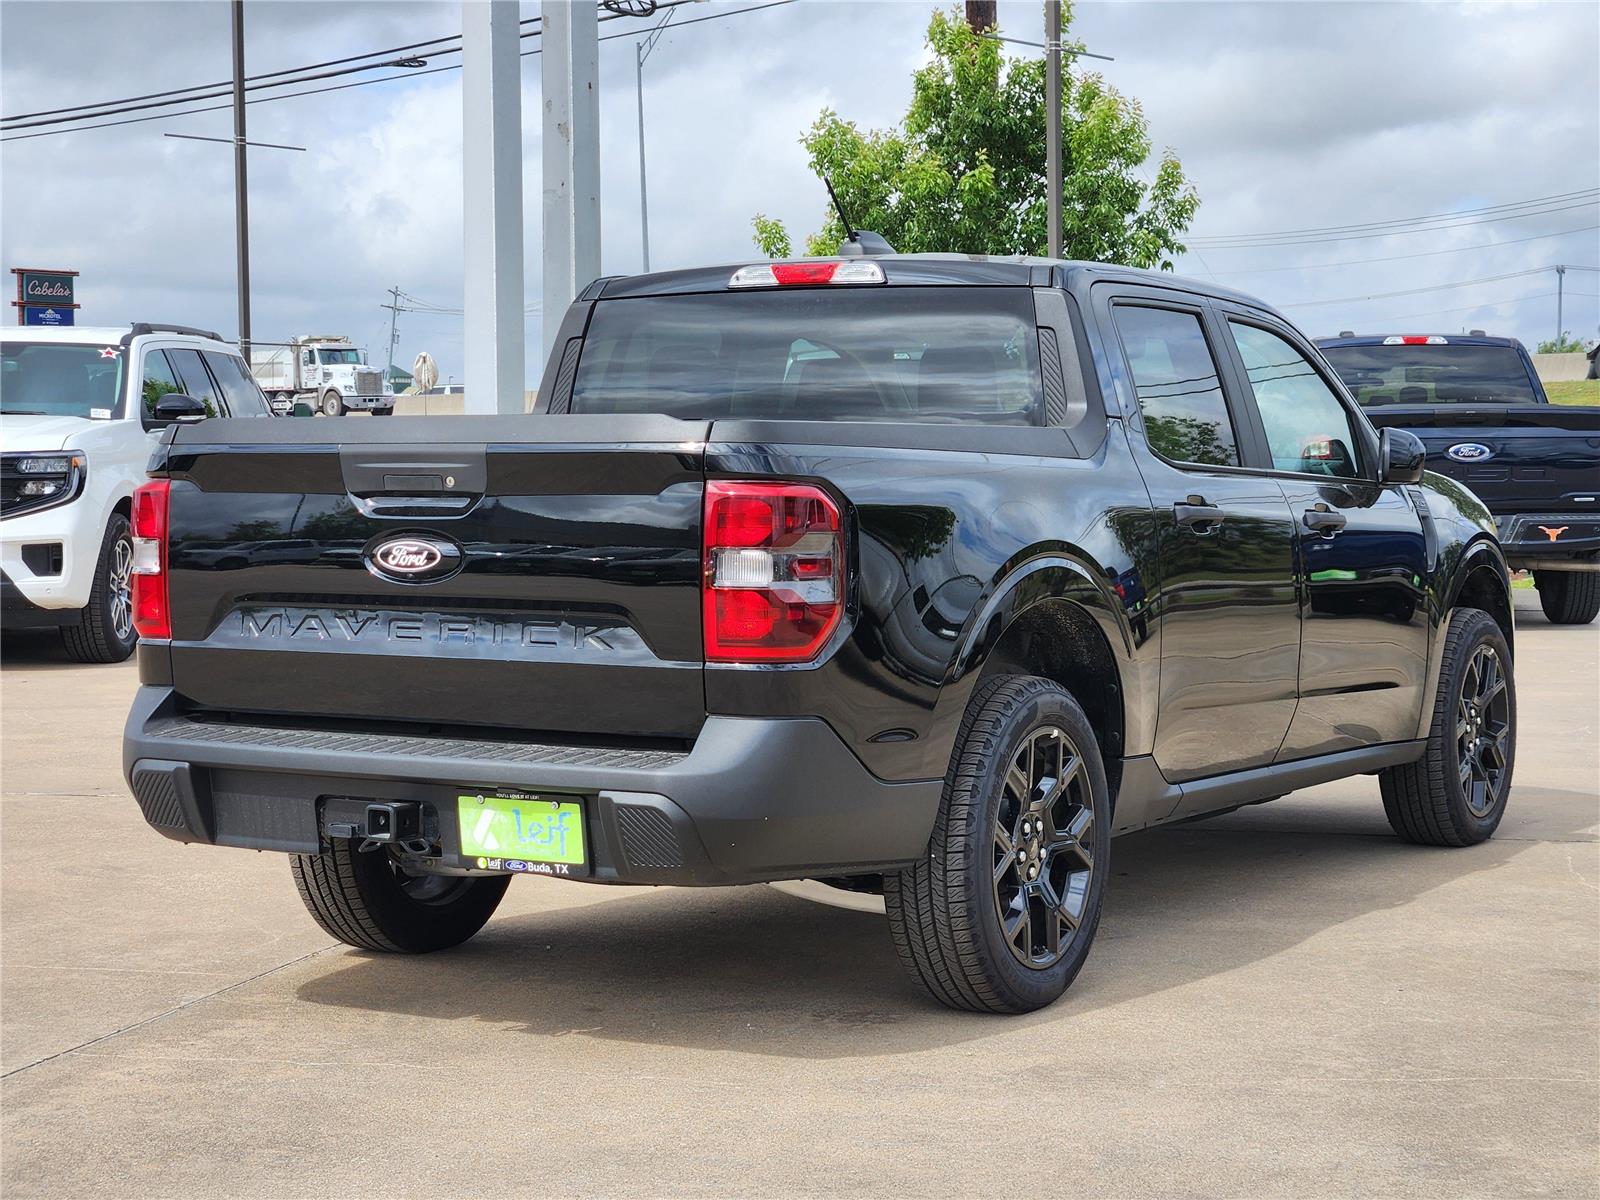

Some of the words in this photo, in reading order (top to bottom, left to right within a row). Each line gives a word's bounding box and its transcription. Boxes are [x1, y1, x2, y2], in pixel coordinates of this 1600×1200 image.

[28, 280, 71, 297] Cabela's
[1458, 447, 1480, 458] Ford
[388, 545, 428, 566] Ford
[240, 613, 614, 650] MAVERICK
[487, 858, 501, 869] leif
[527, 862, 553, 874] Buda,
[555, 863, 569, 874] TX
